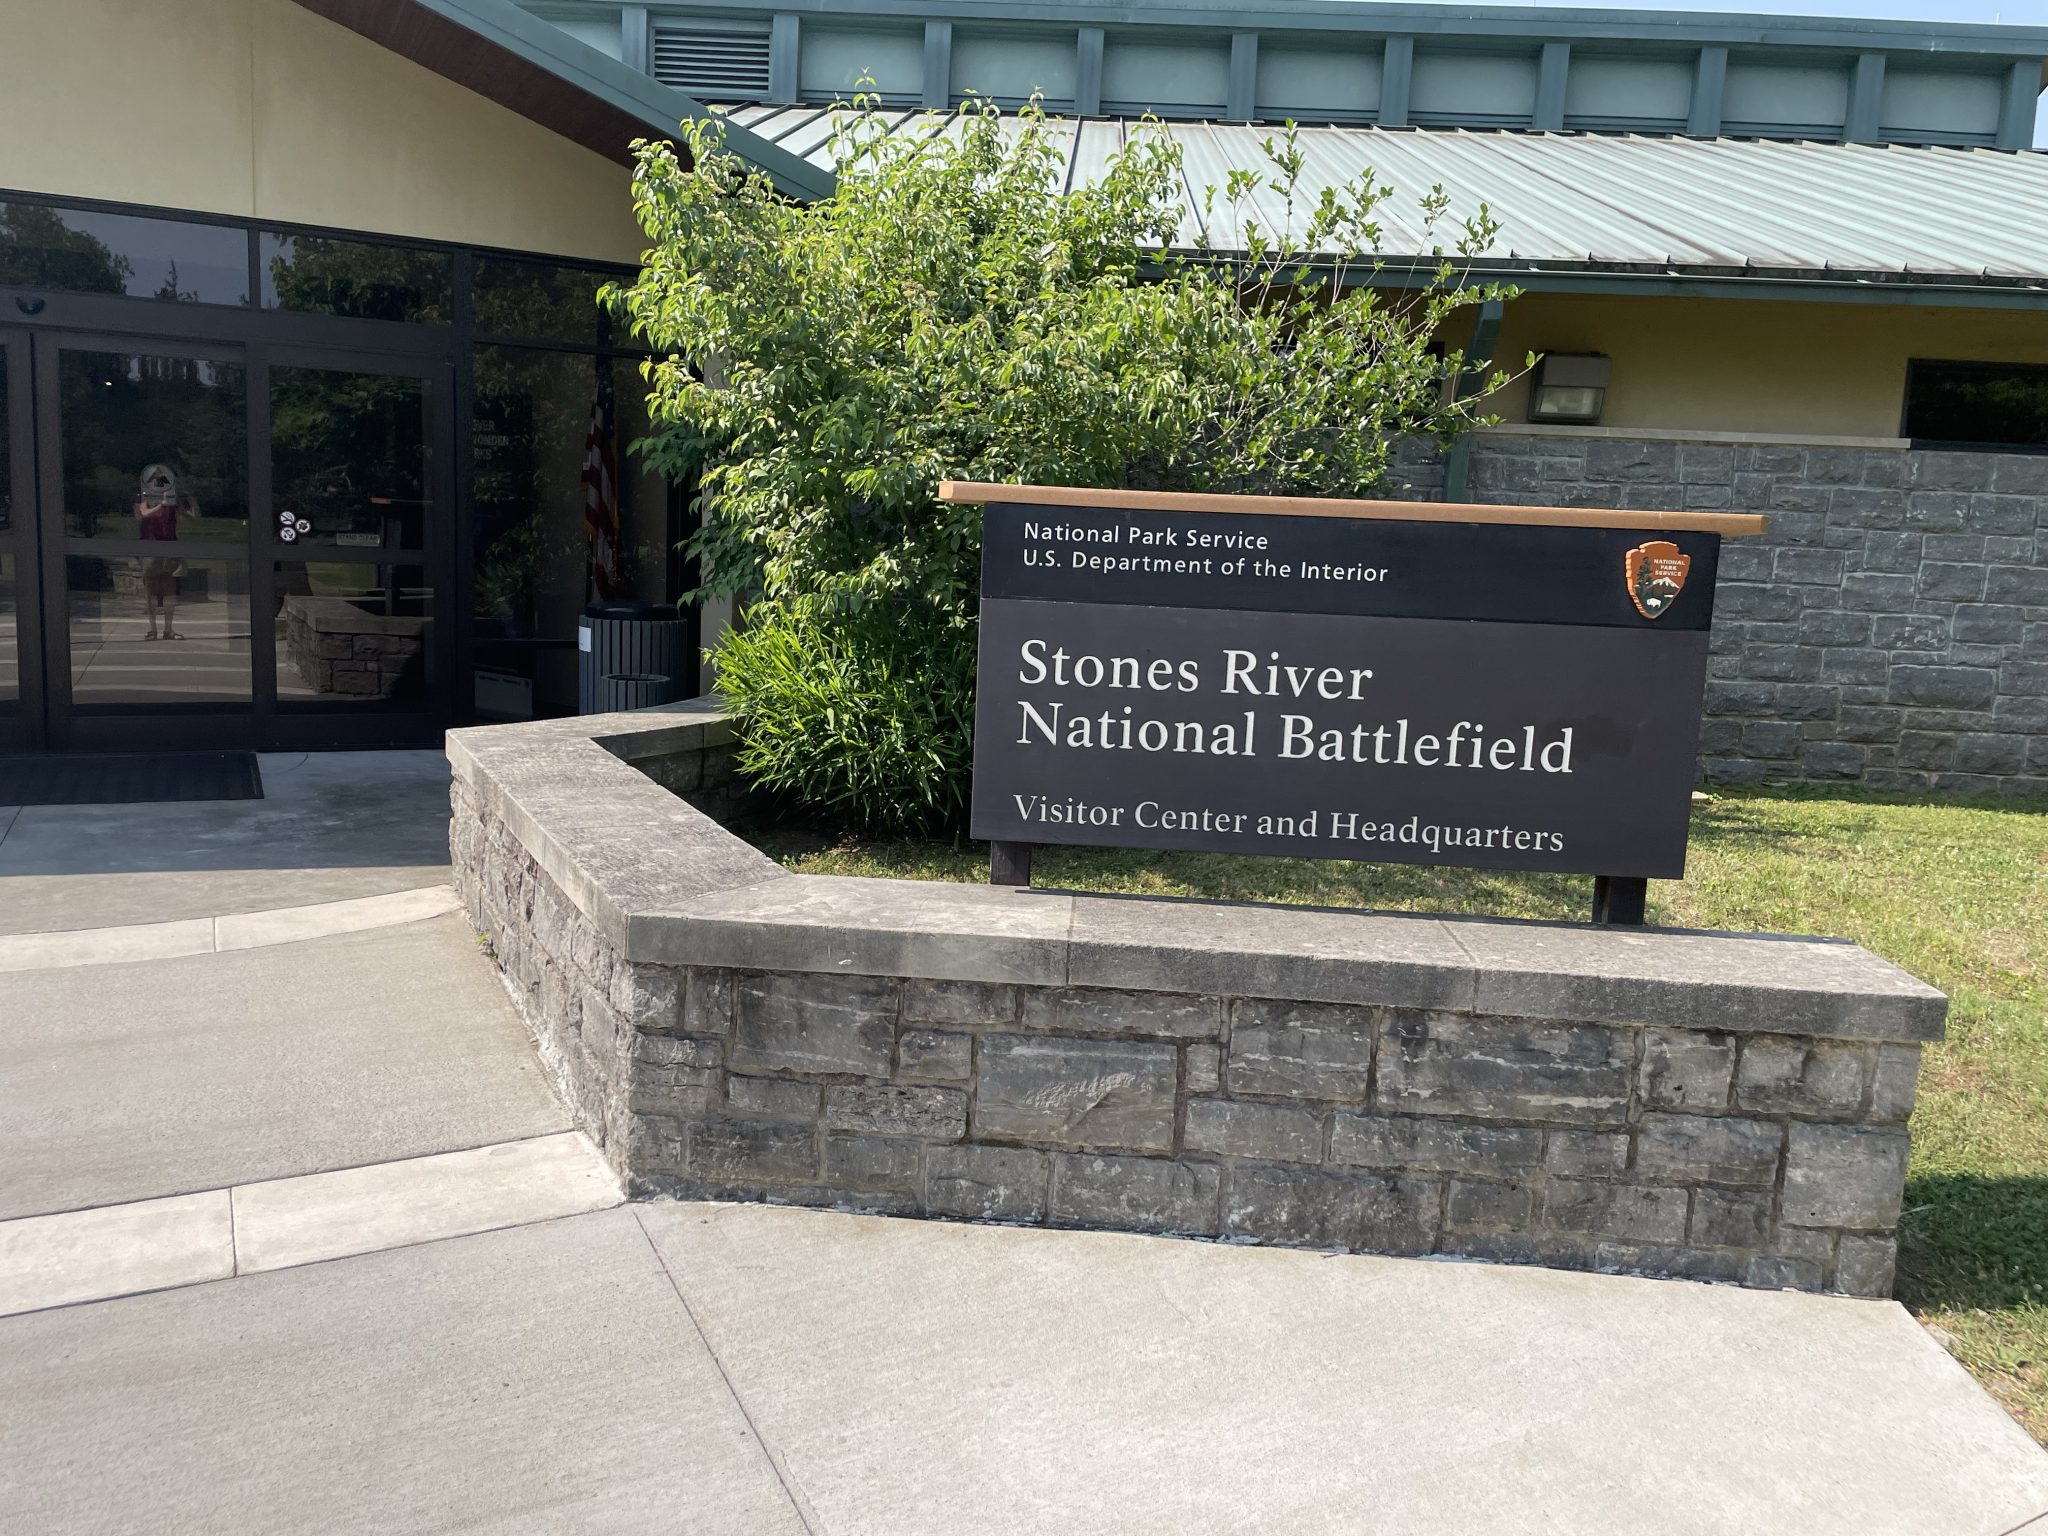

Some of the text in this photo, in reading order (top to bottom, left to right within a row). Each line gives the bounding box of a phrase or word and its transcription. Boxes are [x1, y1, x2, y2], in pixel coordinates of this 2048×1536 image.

[1024, 522, 1268, 550] National Park Service
[1023, 548, 1389, 583] U.S. Department of the Interior
[1653, 558, 1686, 566] NATIONAL
[1019, 639, 1374, 701] Stones River
[1016, 700, 1573, 773] National Battlefield
[1013, 794, 1564, 855] Visitor Center and Headquarters
